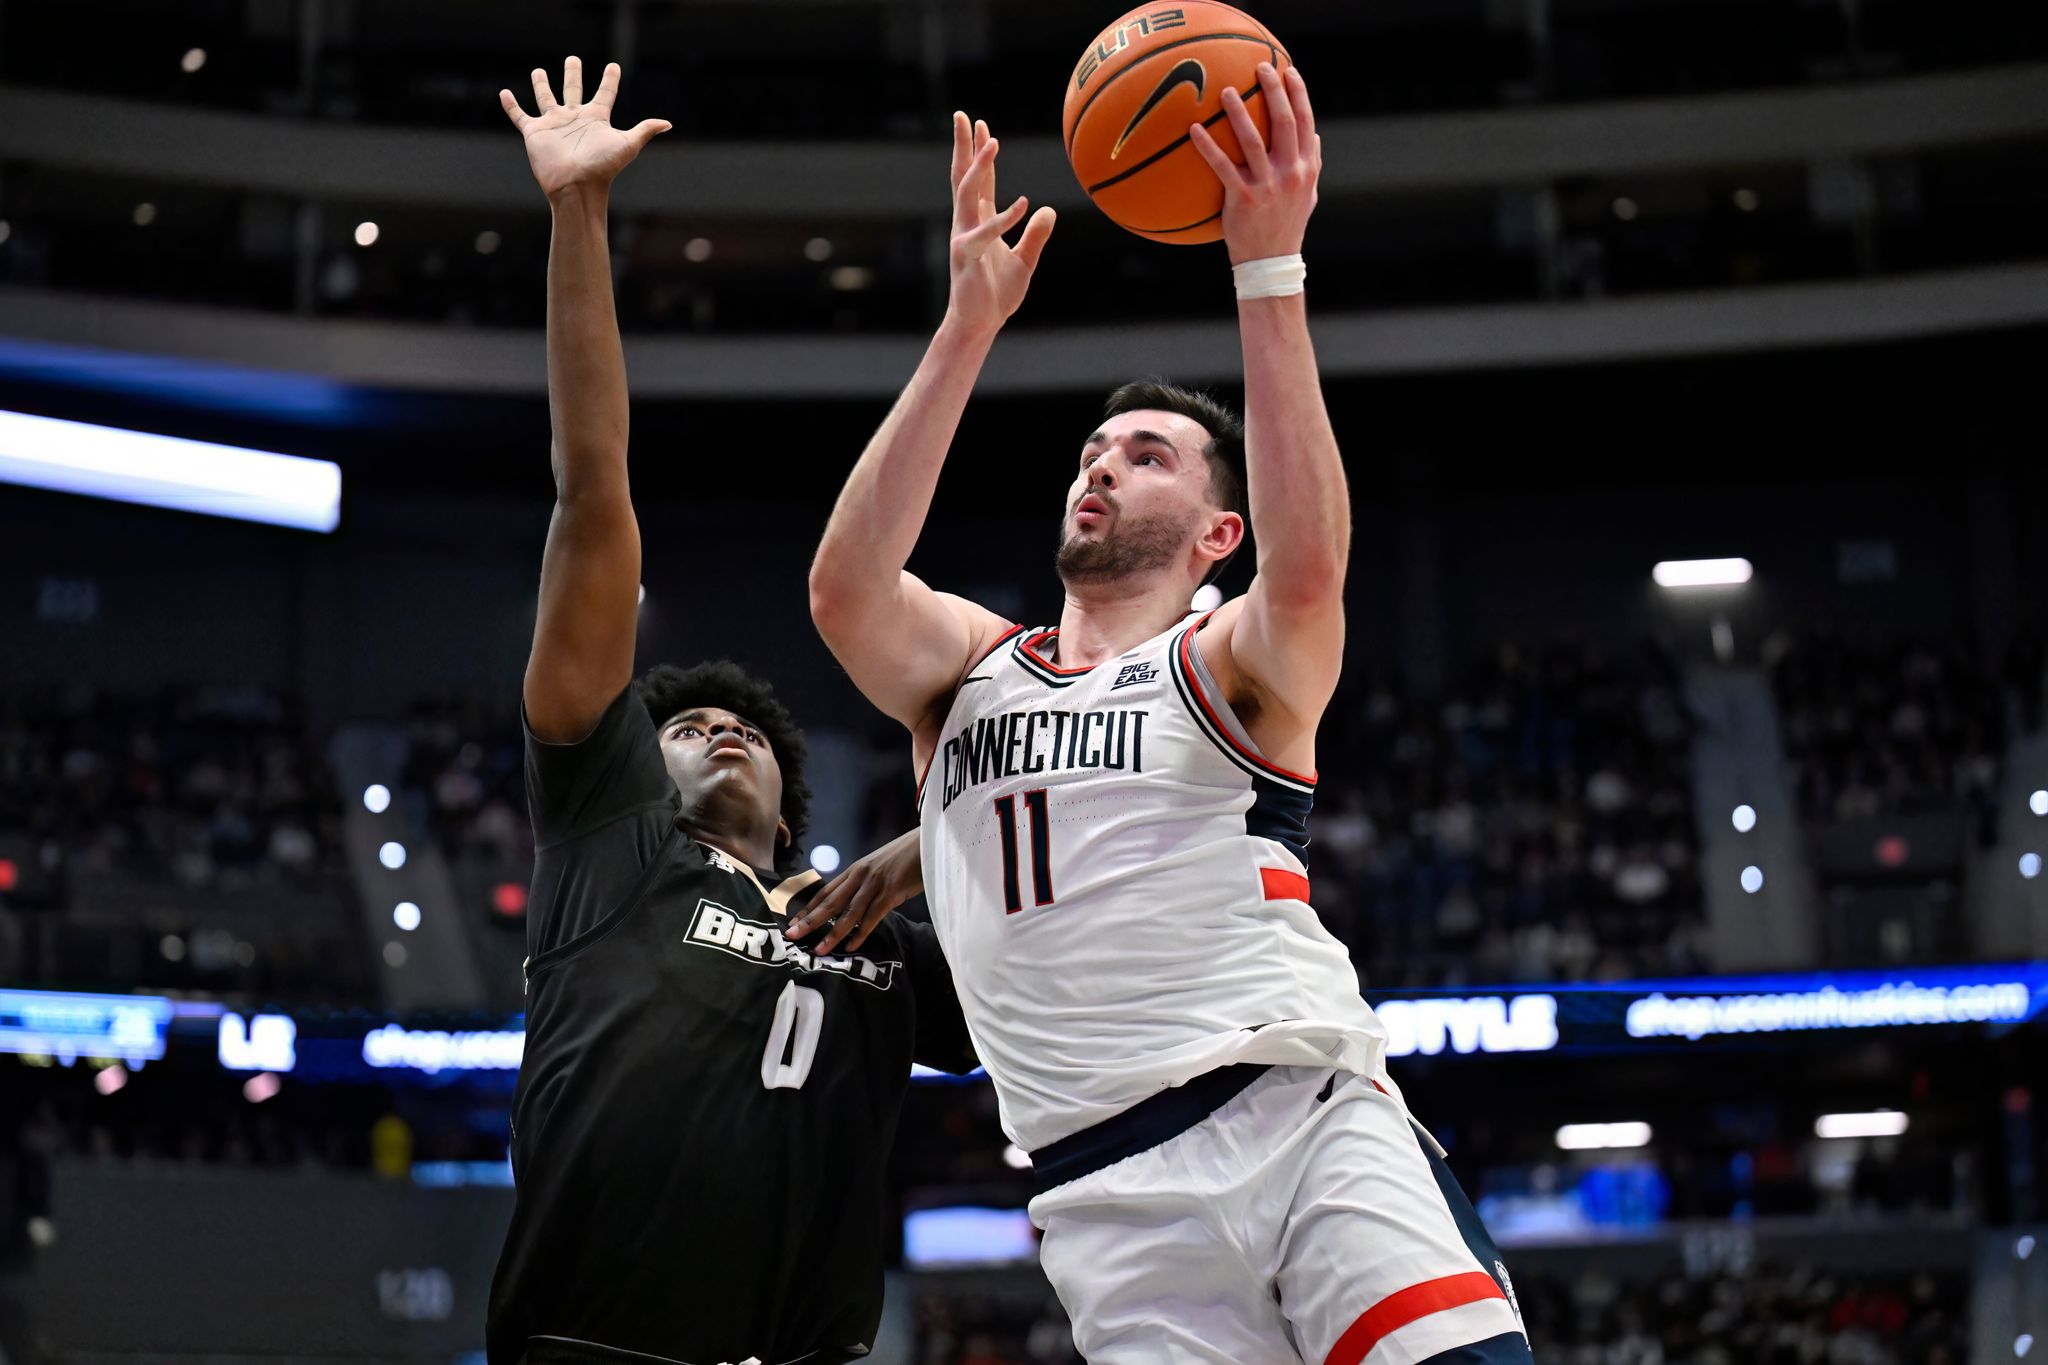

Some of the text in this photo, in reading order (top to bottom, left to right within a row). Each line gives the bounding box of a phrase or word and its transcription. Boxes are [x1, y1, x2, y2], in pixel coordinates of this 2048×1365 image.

[1076, 9, 1186, 90] ELITE
[1113, 669, 1160, 685] EAST
[1119, 660, 1152, 676] BIG
[942, 710, 1149, 812] CONNECTICUT
[994, 788, 1055, 915] 11
[761, 979, 825, 1090] 0
